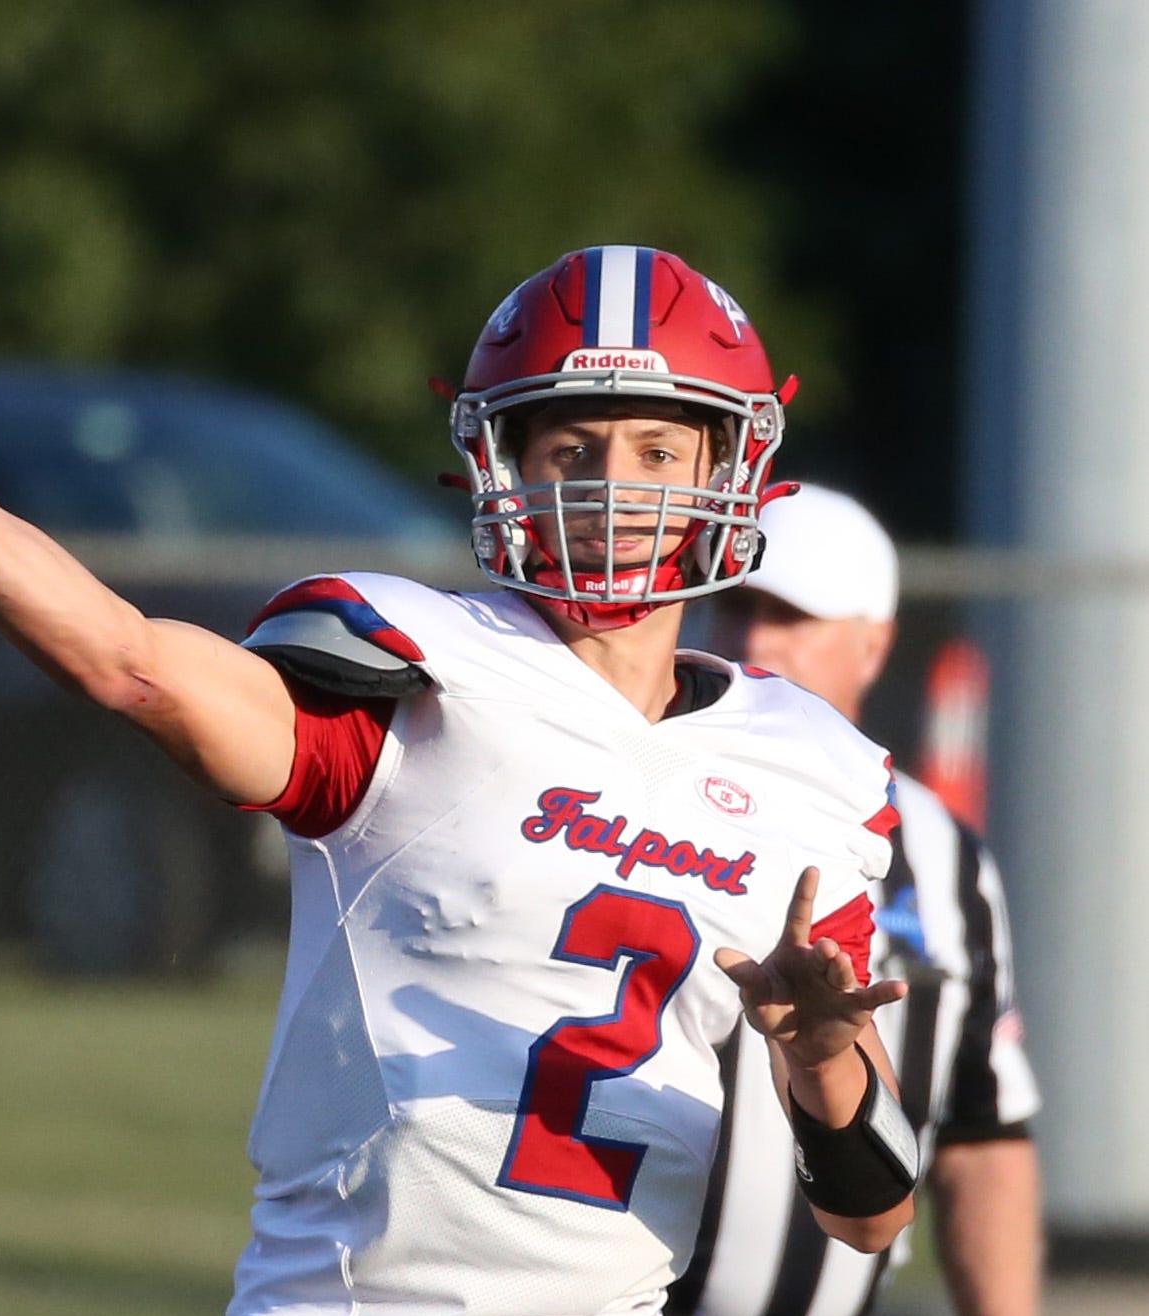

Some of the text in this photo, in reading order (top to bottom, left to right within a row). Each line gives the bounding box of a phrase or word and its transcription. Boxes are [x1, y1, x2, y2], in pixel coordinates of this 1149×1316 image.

[573, 354, 656, 371] Riddell
[586, 579, 629, 591] Ridell
[496, 882, 702, 1214] 2
